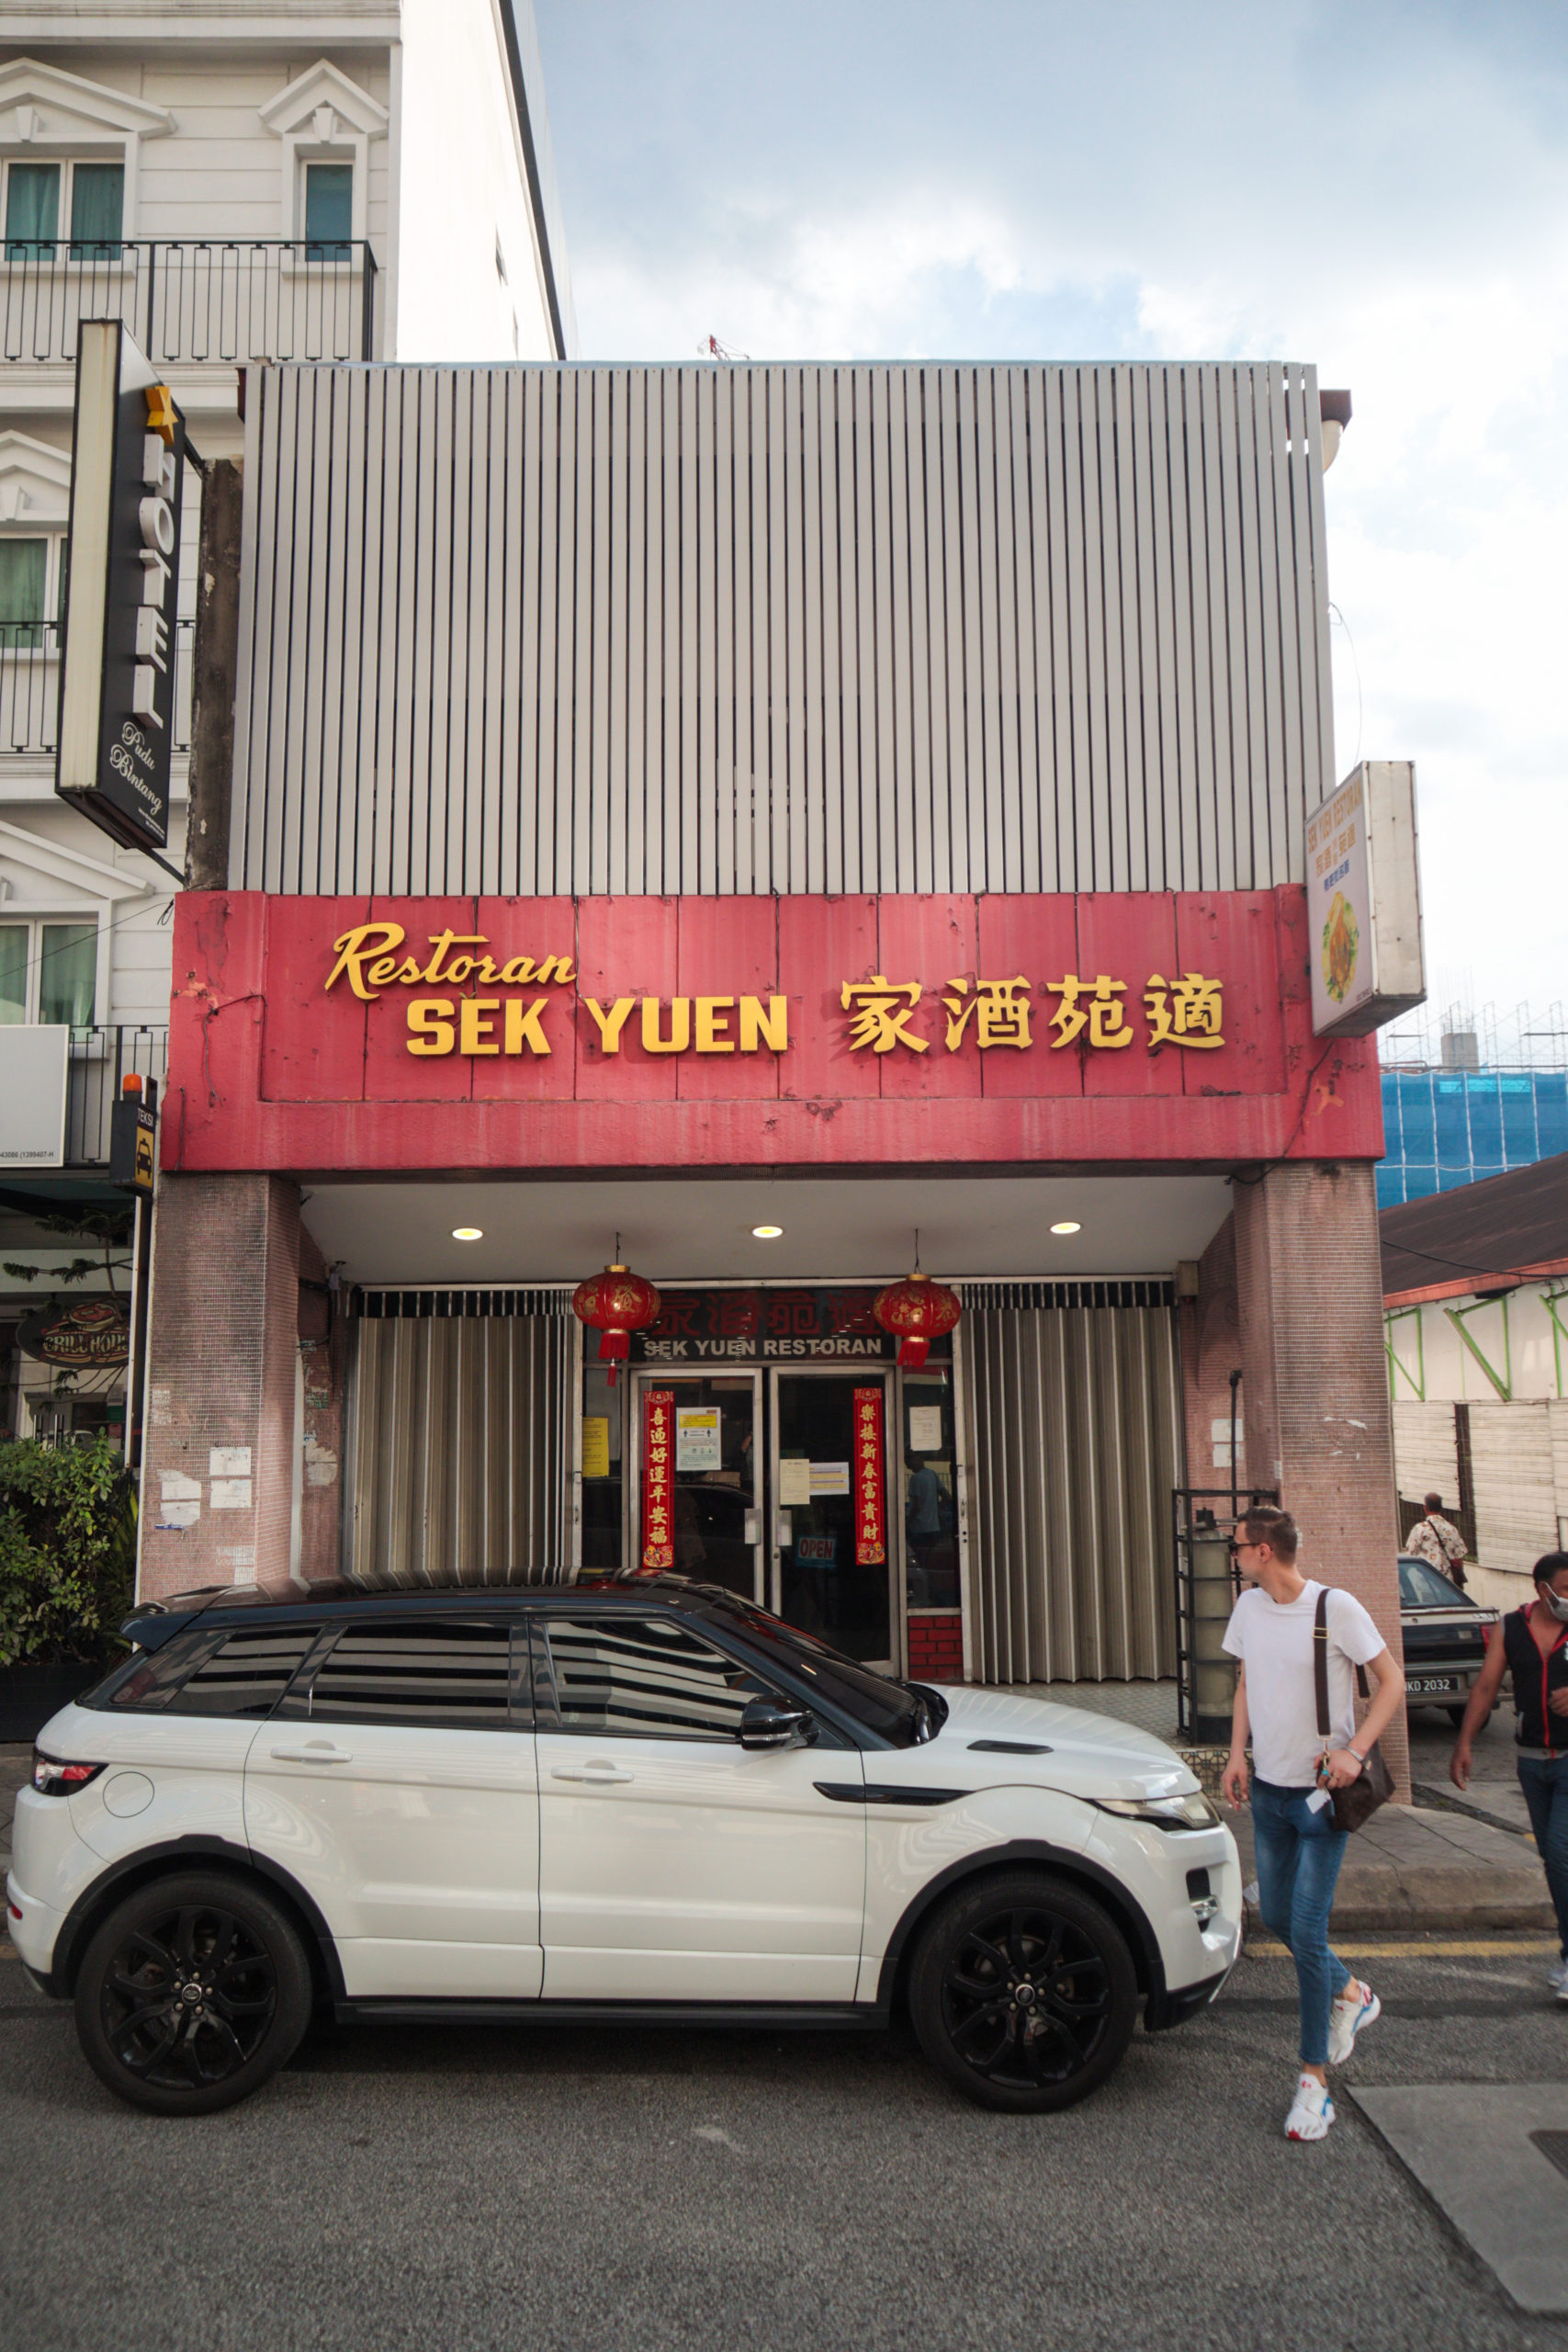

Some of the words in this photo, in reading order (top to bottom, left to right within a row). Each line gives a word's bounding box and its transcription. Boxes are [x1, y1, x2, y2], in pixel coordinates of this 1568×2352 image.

[133, 434, 175, 729] HOTEL
[122, 721, 154, 770] Pudu
[110, 744, 162, 815] Bintang
[324, 922, 577, 1000] Restoran
[406, 998, 552, 1056] SEK
[583, 995, 788, 1054] YUEN
[138, 1106, 153, 1127] TEKSI
[643, 1340, 689, 1356] SEK
[694, 1340, 756, 1356] YUEN
[763, 1339, 882, 1356] RESTORAN
[799, 1538, 835, 1559] OPEN
[1423, 1679, 1450, 1691] 2032
